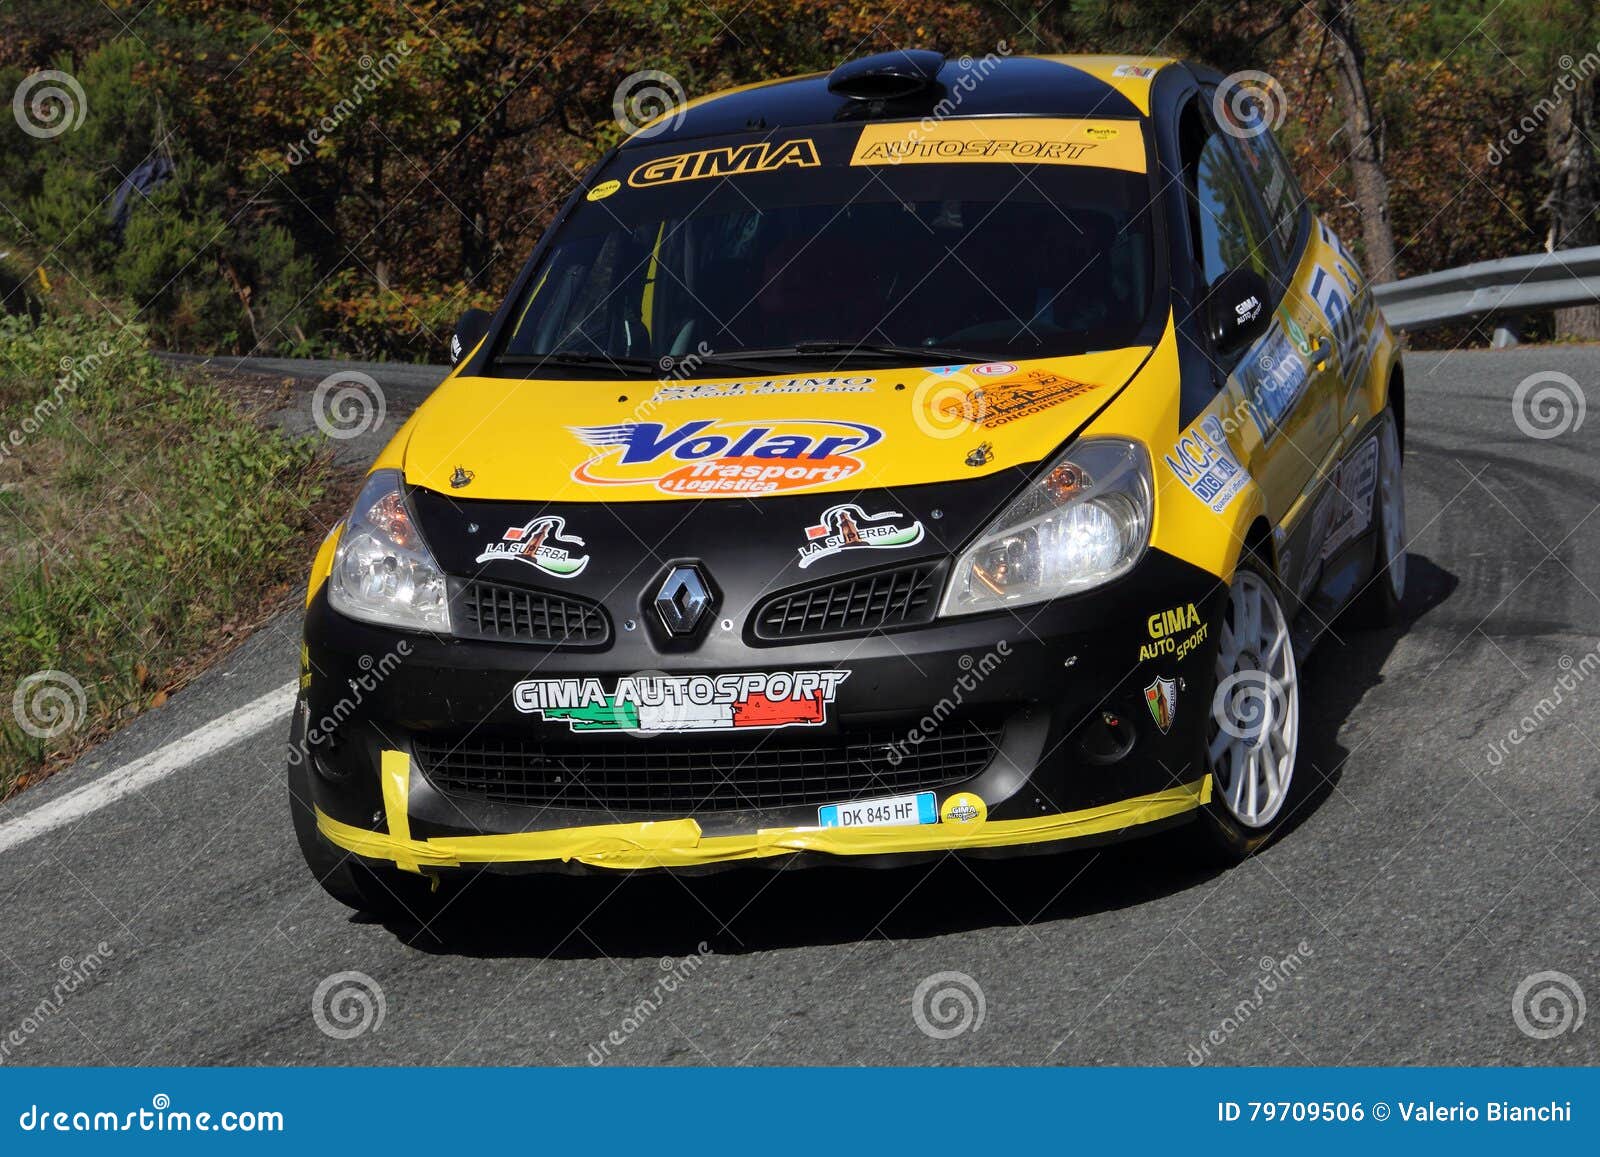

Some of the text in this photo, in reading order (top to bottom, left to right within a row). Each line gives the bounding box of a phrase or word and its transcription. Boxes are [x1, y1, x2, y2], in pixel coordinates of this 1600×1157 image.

[627, 138, 1099, 188] GIMA AUTOSPORT
[1235, 295, 1259, 315] GIMA
[658, 376, 876, 395] SETTIMO
[984, 384, 1099, 430] CONCORRENTE
[617, 420, 869, 465] Volar
[1165, 428, 1221, 488] MCA
[689, 460, 854, 482] Trasporti
[486, 543, 568, 562] LA SUPERBA
[799, 525, 899, 558] LA SUPERBA
[1148, 603, 1200, 639] GIMA
[1139, 623, 1209, 662] AUTO SPORT
[514, 671, 850, 709] GIMA AUTOSPORT
[842, 802, 913, 826] DK 845 HF
[951, 805, 977, 814] GIMA
